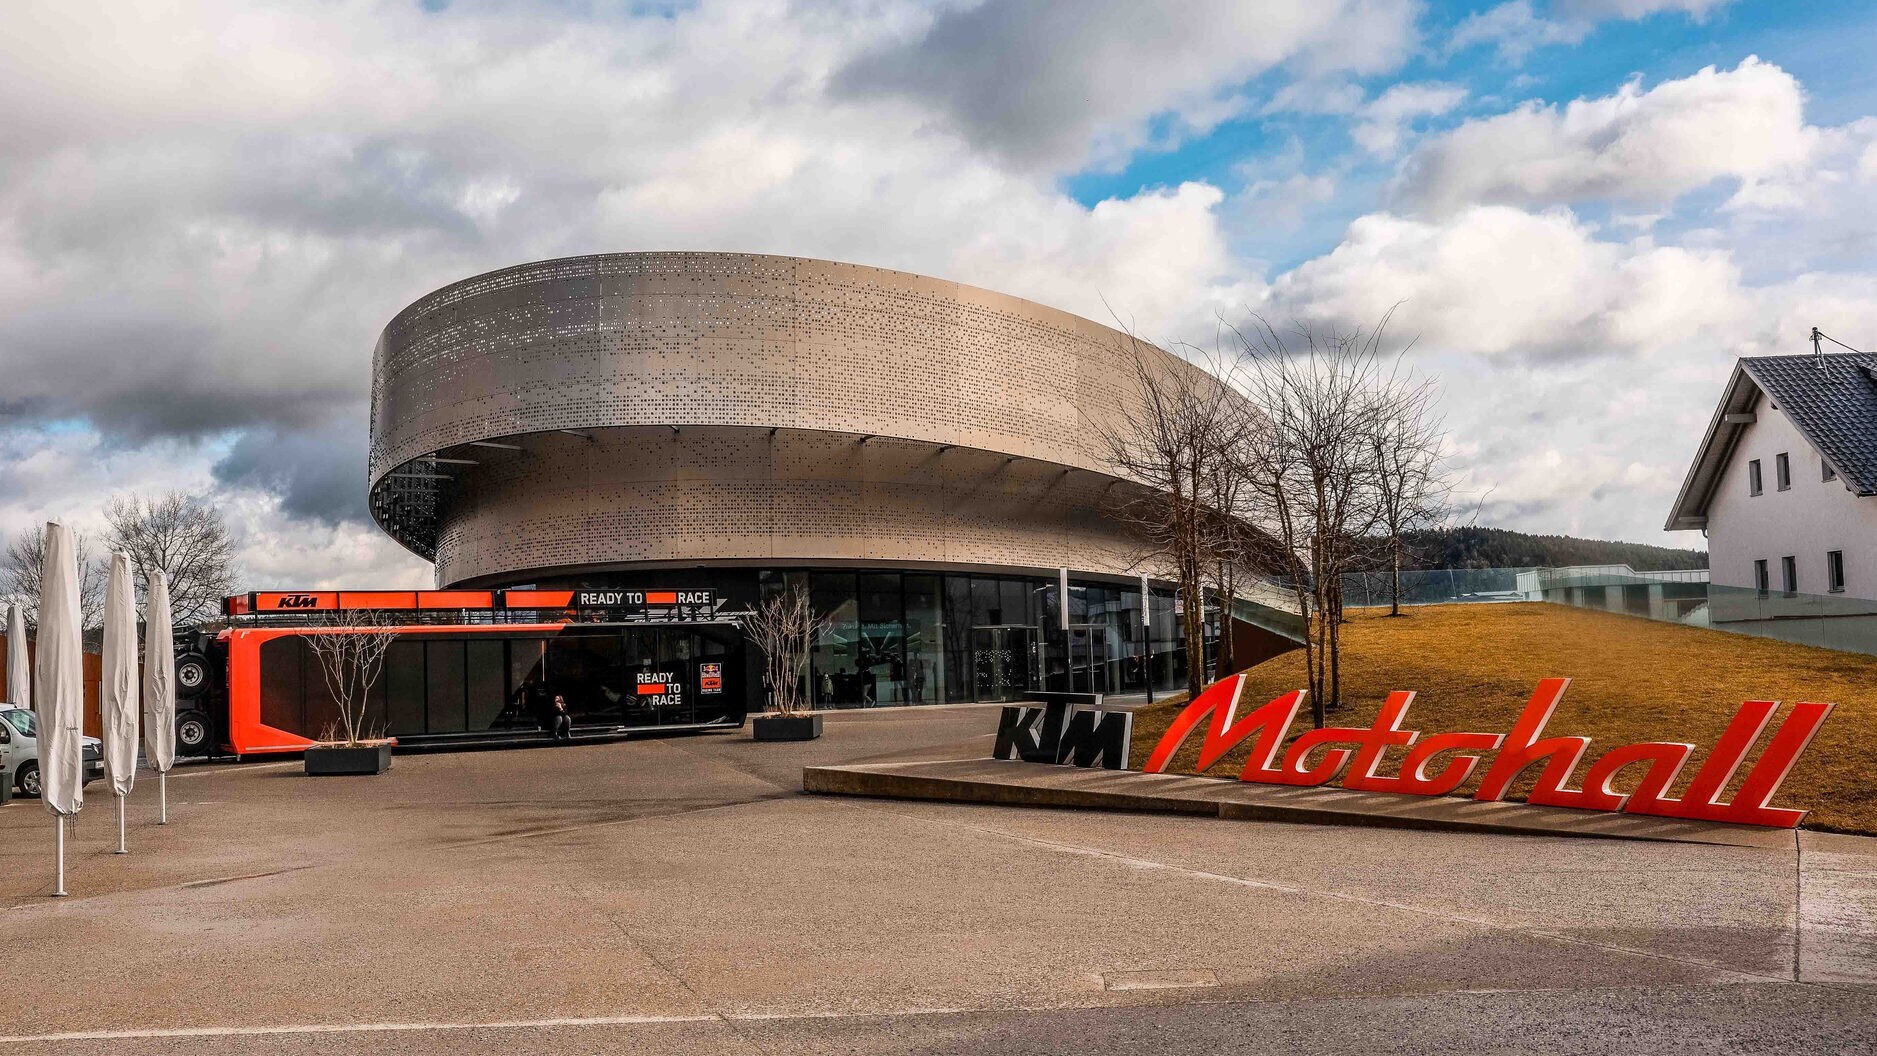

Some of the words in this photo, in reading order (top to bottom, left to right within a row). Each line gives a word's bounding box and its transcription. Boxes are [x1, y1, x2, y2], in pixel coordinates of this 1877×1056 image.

[277, 594, 318, 608] KTM
[581, 593, 623, 605] READY
[626, 593, 643, 604] TO
[678, 592, 710, 604] RACE
[637, 672, 674, 683] READY
[666, 683, 681, 693] TO
[652, 694, 682, 706] RACE
[993, 691, 1133, 770] KTM
[1145, 674, 1836, 829] Motohall
